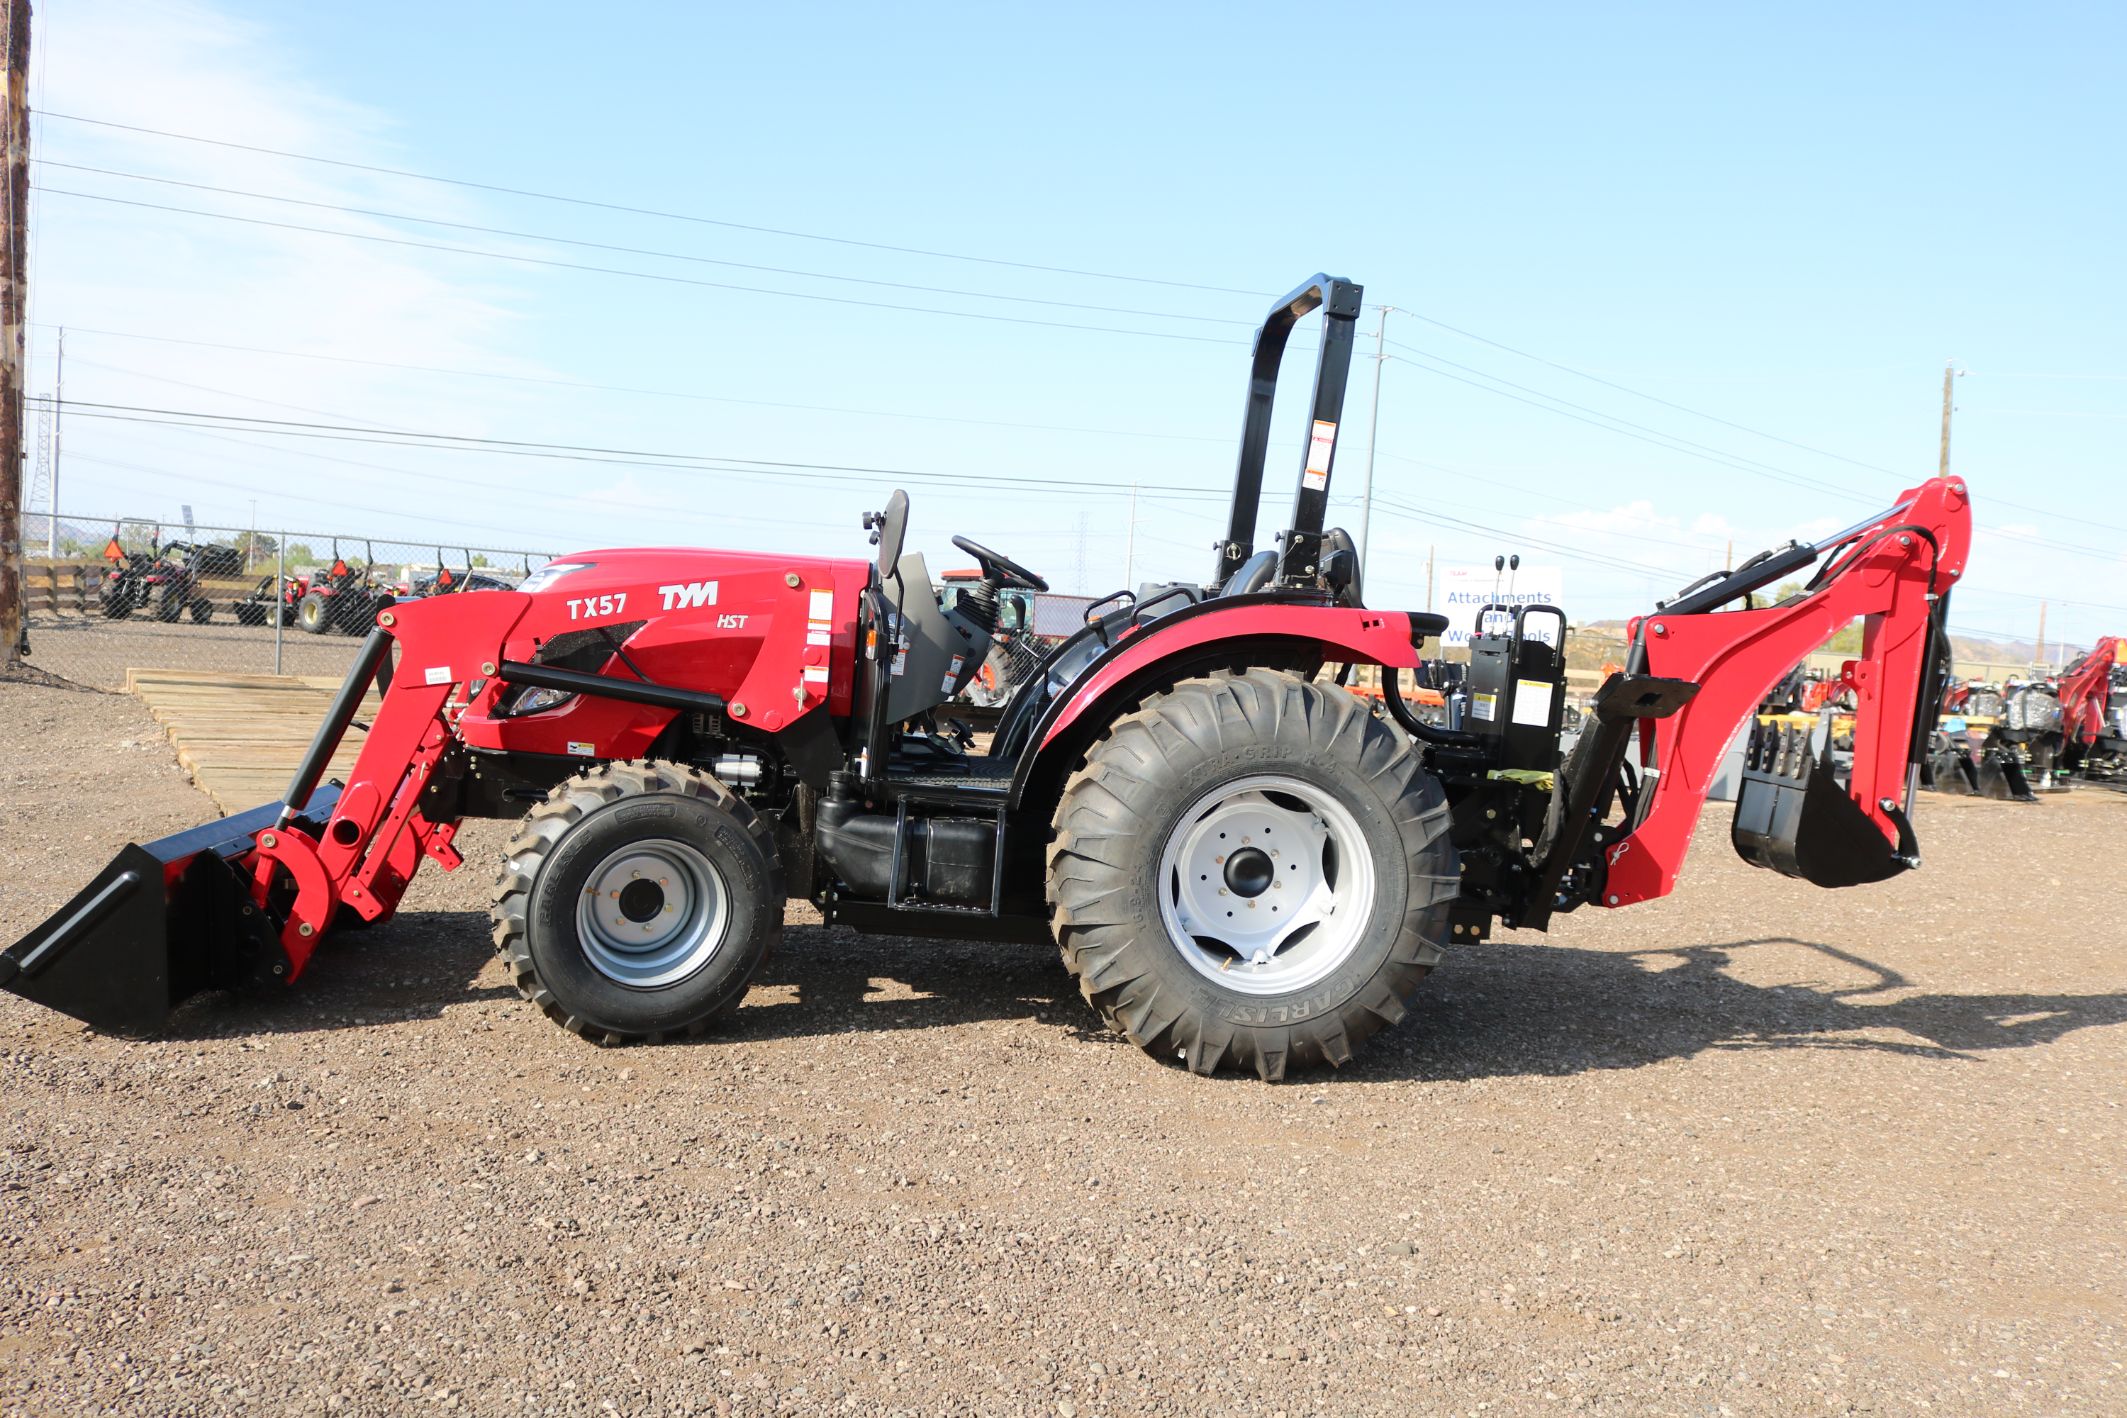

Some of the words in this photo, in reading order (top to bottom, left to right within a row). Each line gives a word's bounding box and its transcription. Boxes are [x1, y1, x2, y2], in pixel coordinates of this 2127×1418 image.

[566, 592, 628, 621] TX57
[658, 580, 719, 611] TYM
[1447, 591, 1552, 604] Attachments
[716, 614, 749, 629] HST
